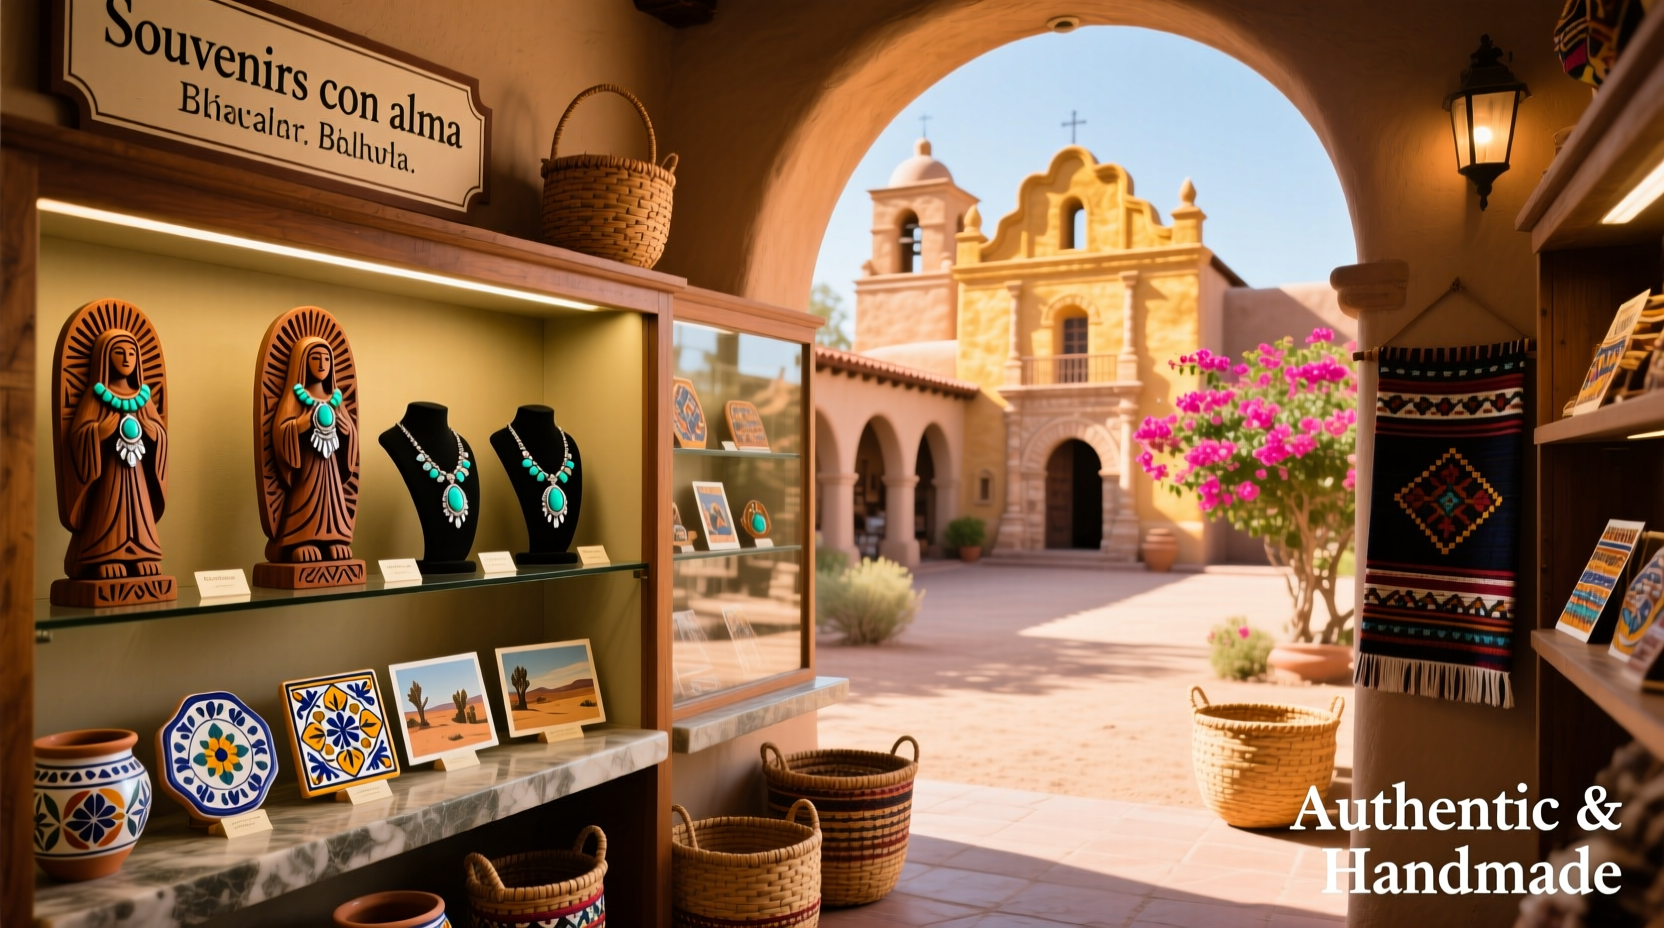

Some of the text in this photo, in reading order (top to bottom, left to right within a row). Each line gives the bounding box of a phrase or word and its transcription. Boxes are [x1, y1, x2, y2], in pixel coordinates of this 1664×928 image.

[105, 0, 463, 149] Souvenirs con alma
